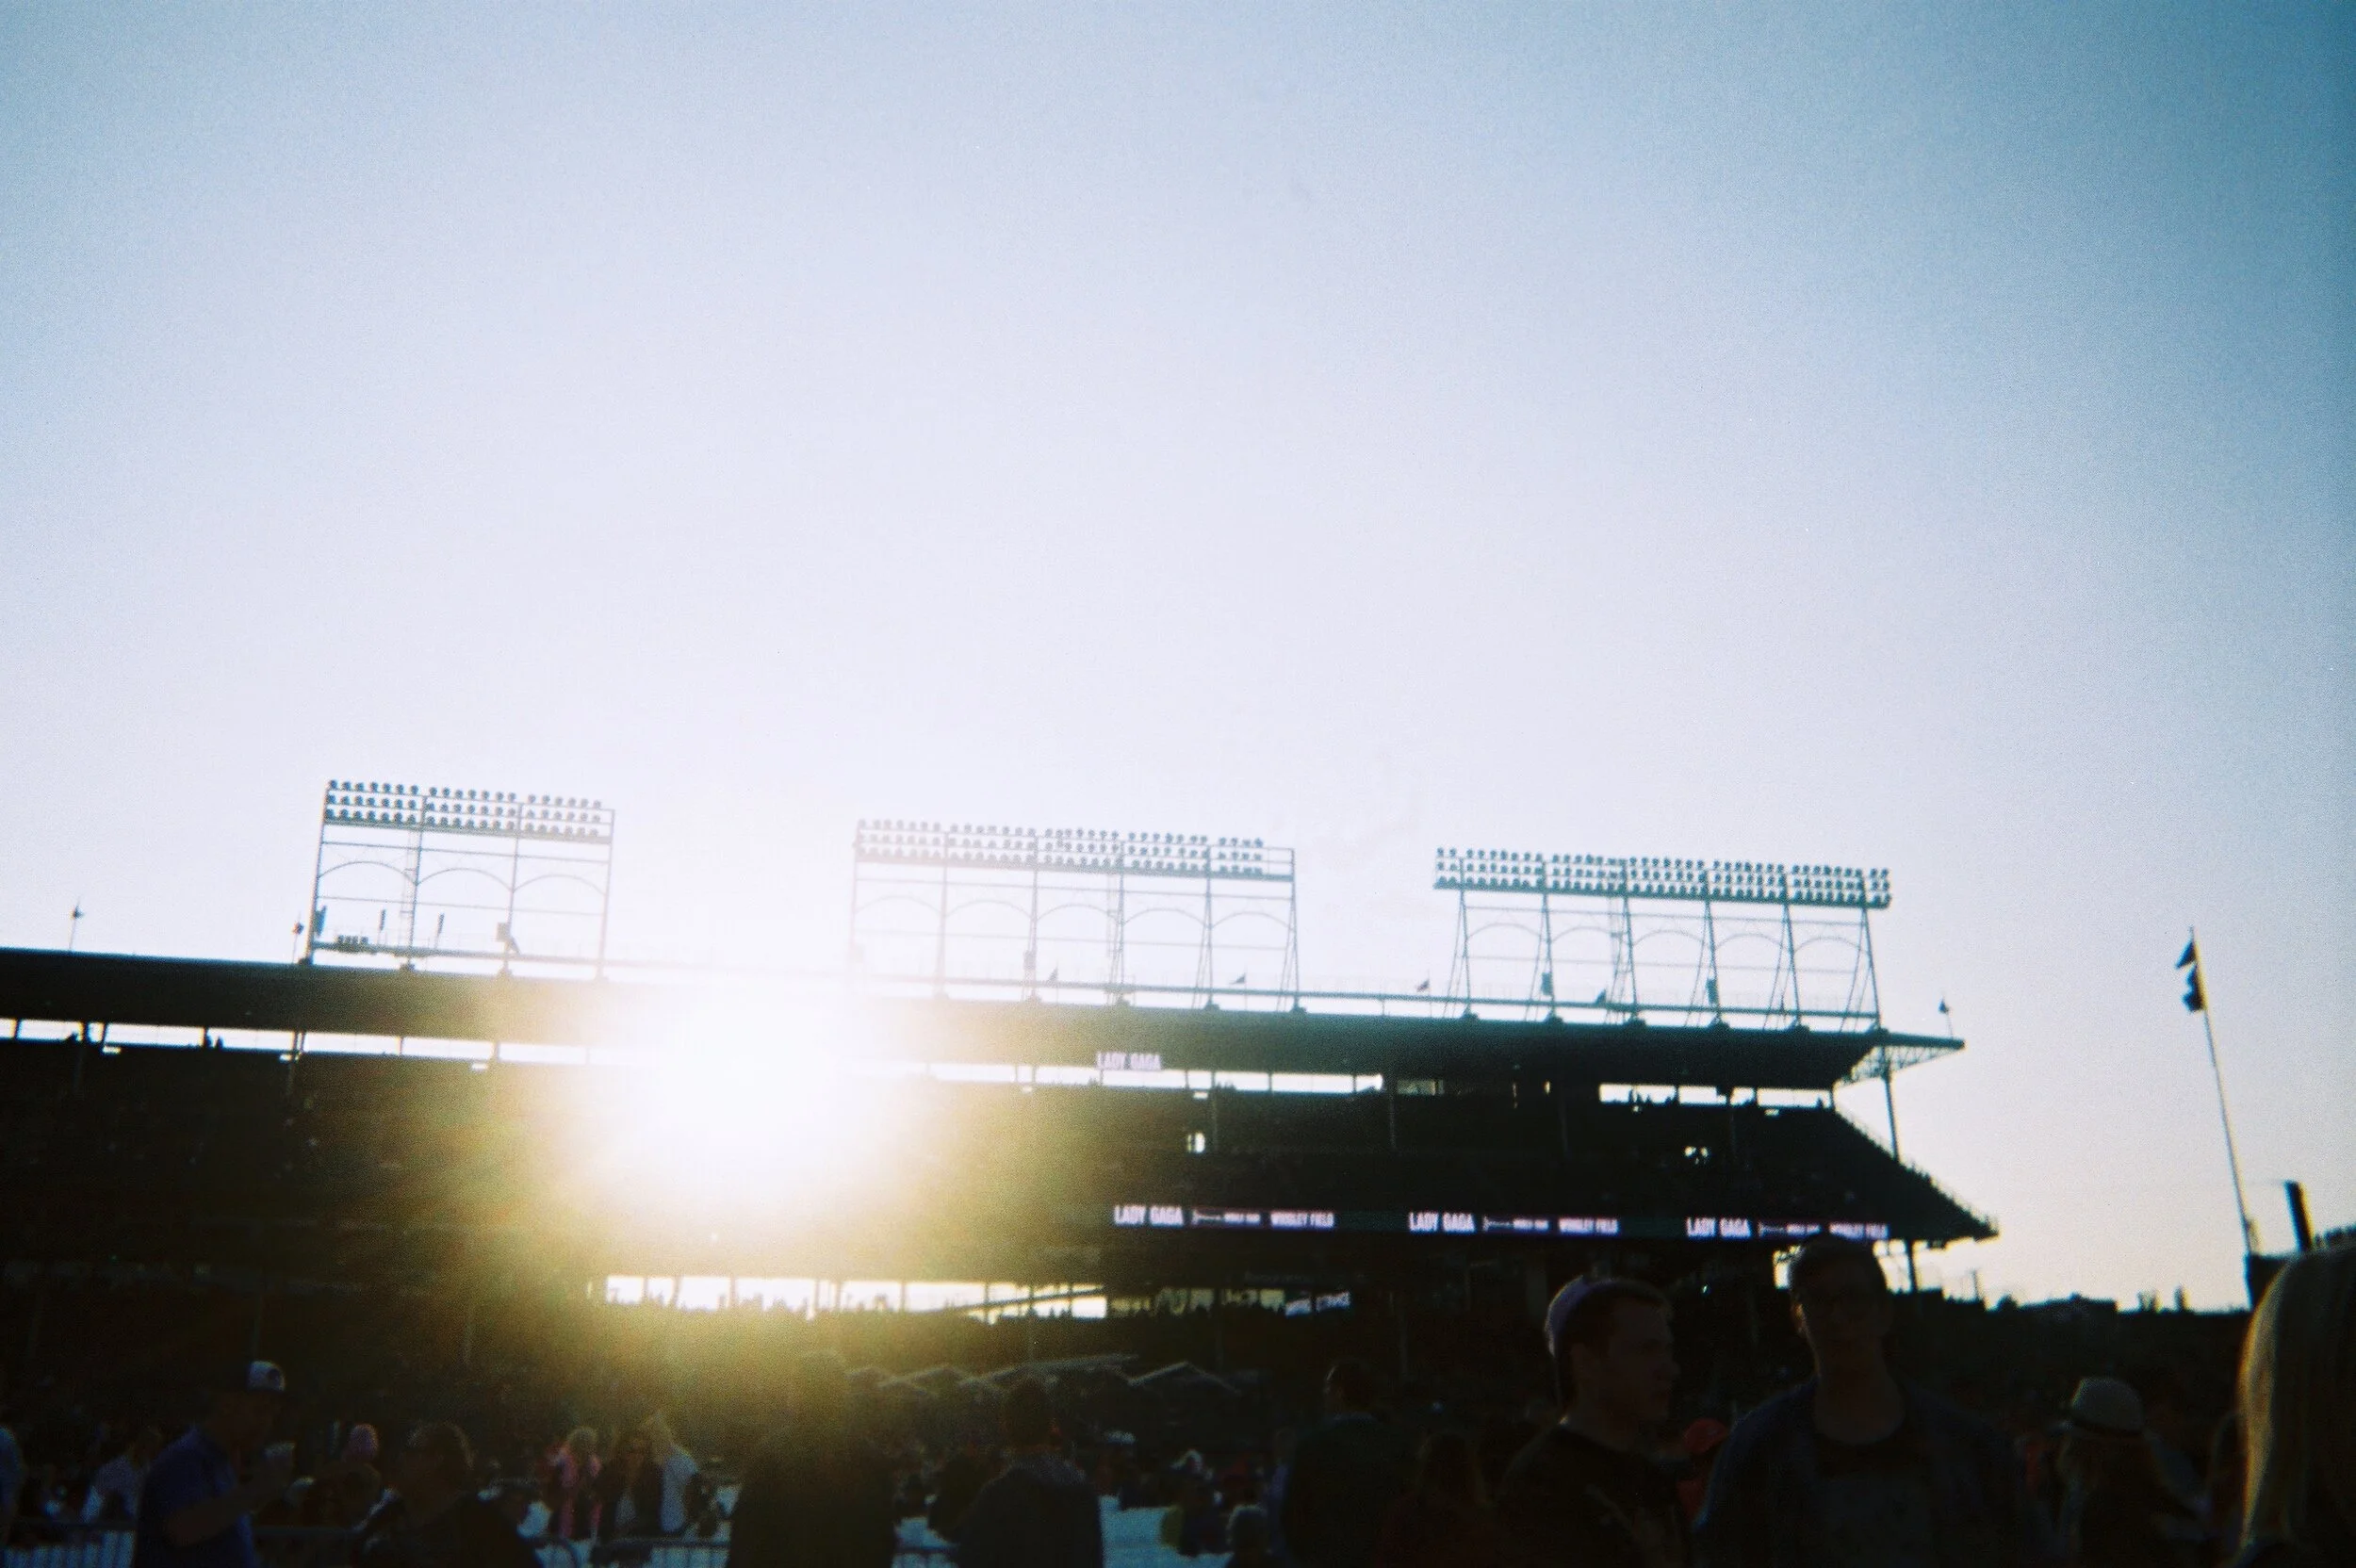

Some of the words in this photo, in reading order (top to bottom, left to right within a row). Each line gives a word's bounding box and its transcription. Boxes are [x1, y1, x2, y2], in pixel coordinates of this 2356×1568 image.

[1096, 1053, 1126, 1070] LADY
[1130, 1053, 1161, 1071] GAGA
[1114, 1204, 1146, 1226] LADY
[1149, 1205, 1184, 1226] GAGA
[1409, 1212, 1439, 1233] LADY
[1442, 1212, 1475, 1233] GAGA
[1686, 1217, 1716, 1237] LADY
[1719, 1217, 1752, 1237] GAGA
